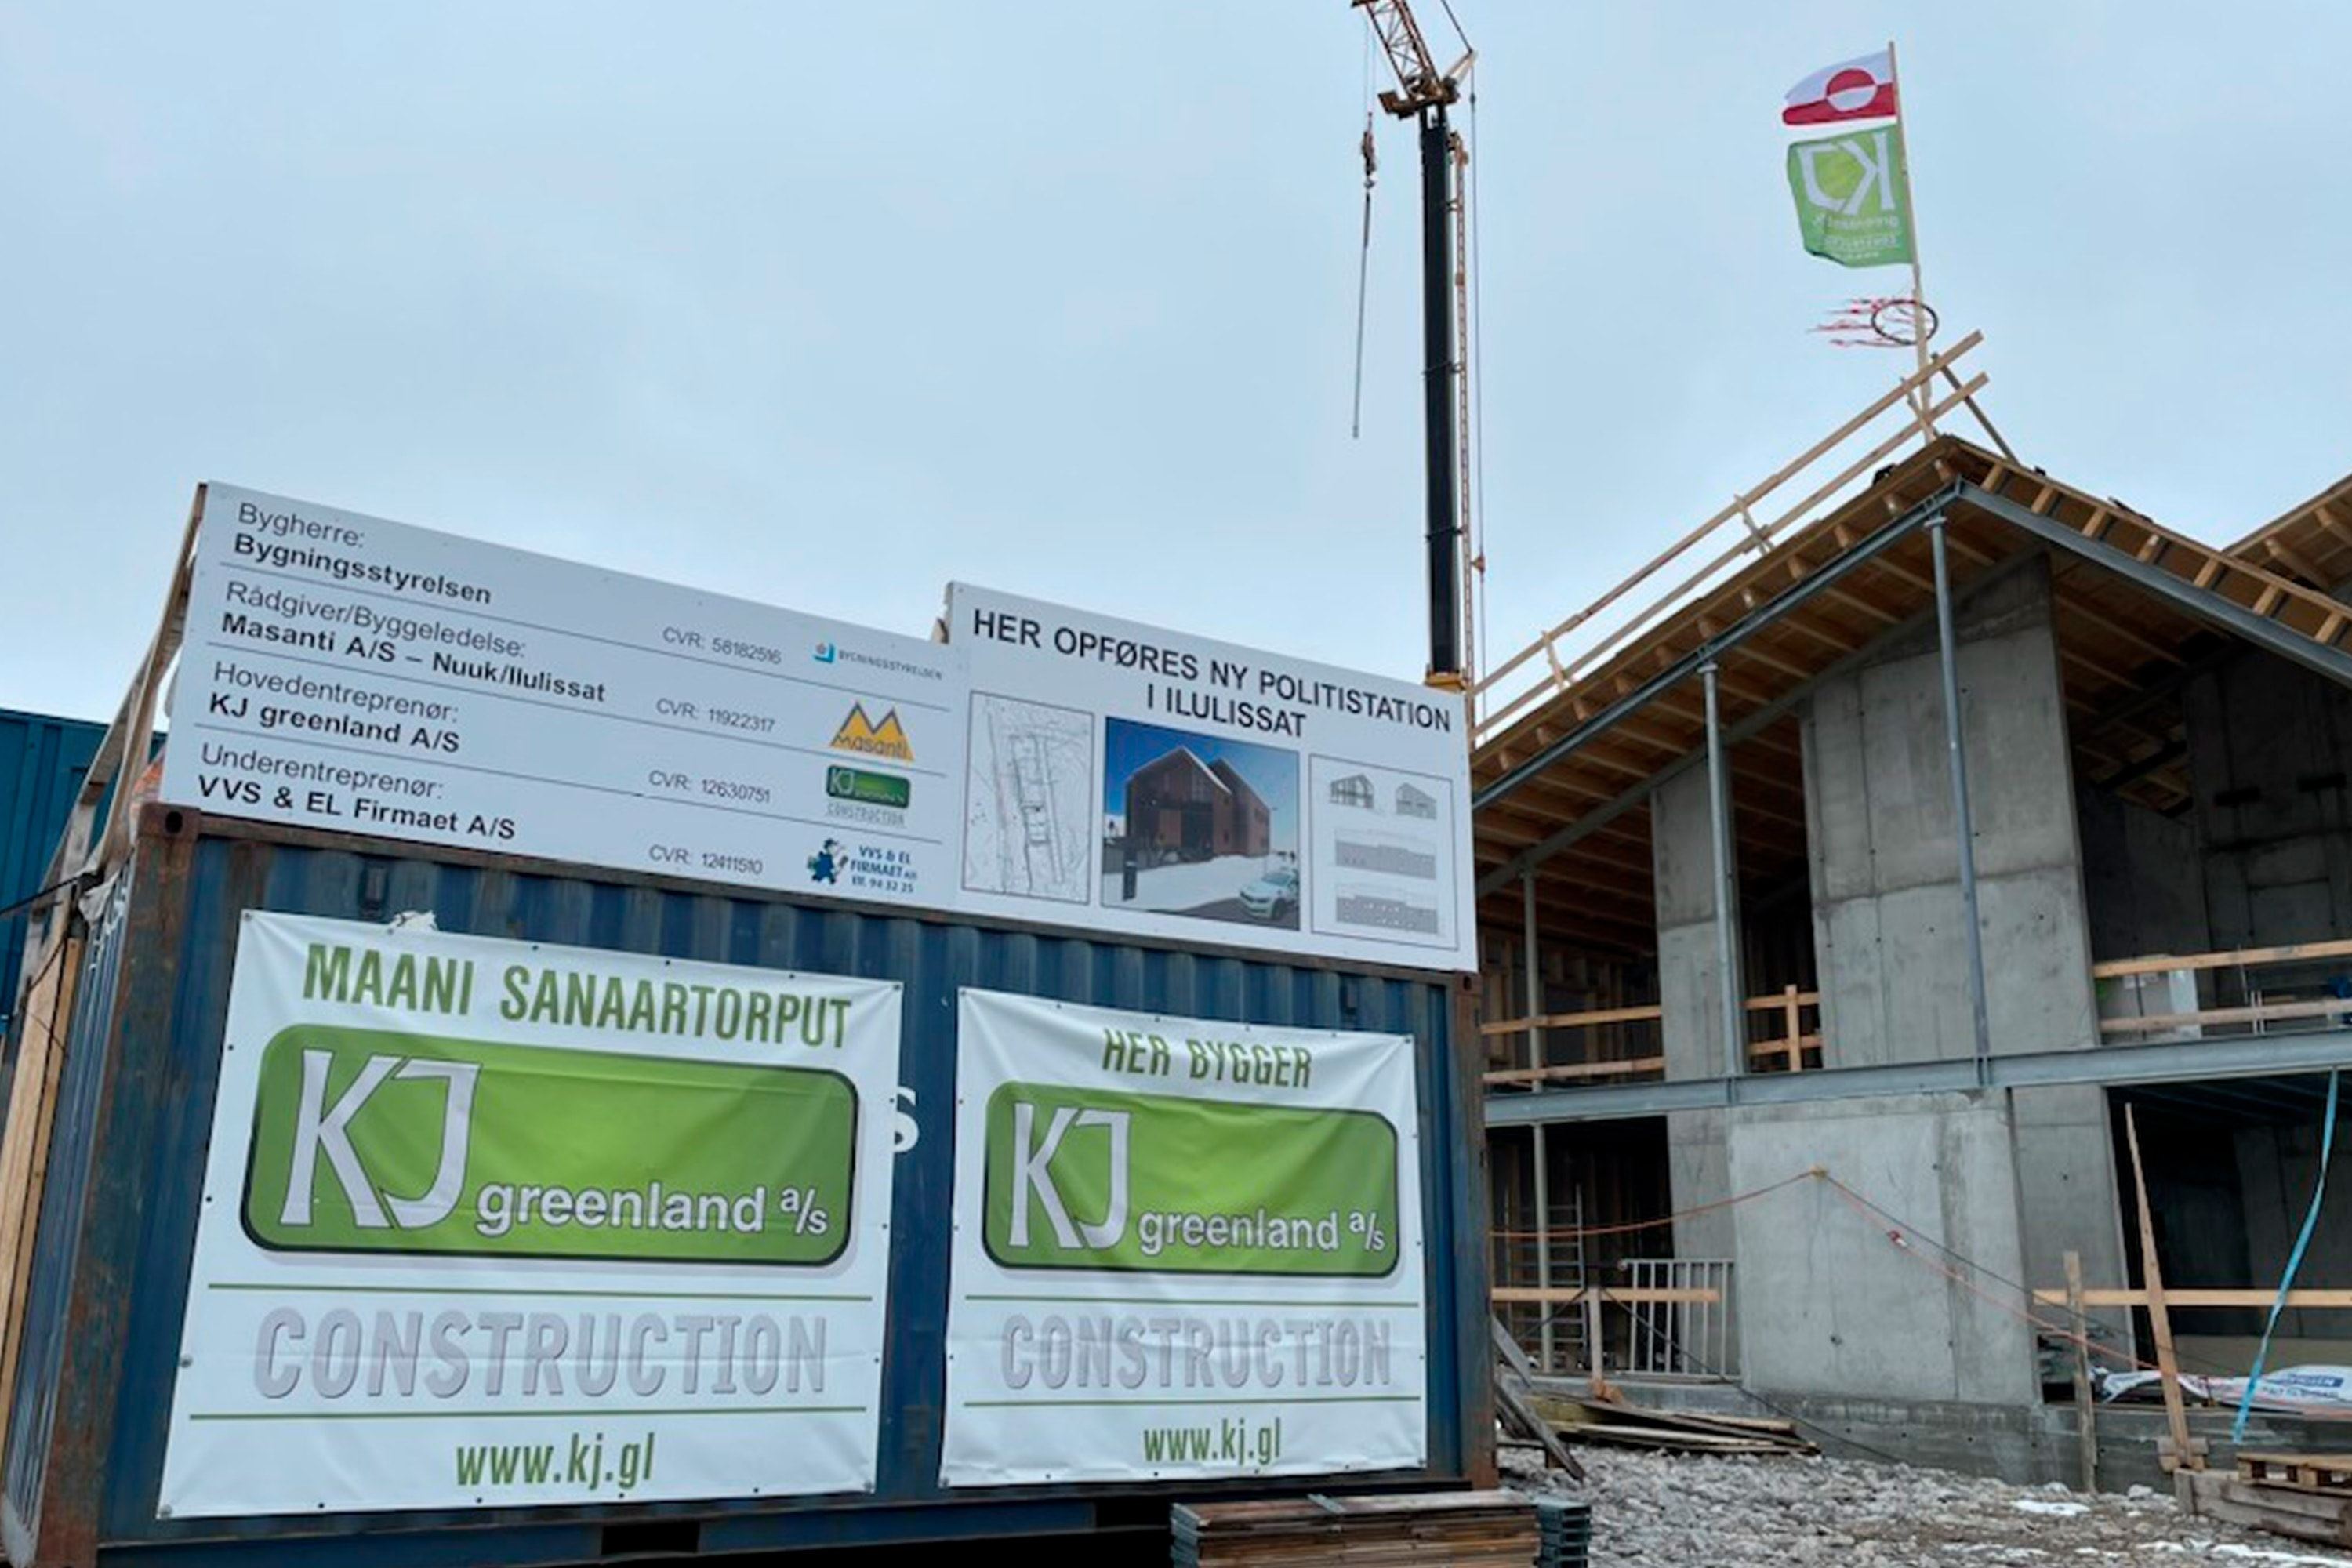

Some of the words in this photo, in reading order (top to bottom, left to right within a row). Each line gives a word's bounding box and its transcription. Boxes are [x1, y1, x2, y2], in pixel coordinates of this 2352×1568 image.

[238, 503, 365, 547] Bygherre:
[234, 532, 492, 601] Bygningsstyrelsen
[226, 580, 525, 657] Rådgiver/Byggeledelse:
[662, 626, 705, 649] CVR:
[221, 612, 336, 651] Masanti
[345, 636, 396, 662] A/S
[433, 652, 605, 702] Nuuk/Ilulissat
[974, 608, 1041, 648] HER
[1054, 627, 1198, 680] OPFØRES
[1211, 660, 1249, 689] NY
[1260, 671, 1450, 732] POLITISTATION
[214, 661, 459, 723] Hovedentreprenør:
[656, 698, 699, 720] CVR:
[709, 708, 775, 733] 11922317
[1148, 684, 1153, 708] I
[1167, 688, 1306, 738] ILULISSAT
[209, 692, 248, 718] KJ
[260, 705, 401, 742] greenland
[410, 728, 459, 753] A/S
[201, 742, 443, 799] Underentreprenør:
[648, 770, 691, 790] CVR:
[702, 779, 770, 803] 12630751
[198, 775, 261, 804] VVS
[274, 786, 294, 809] &
[307, 791, 342, 816] EL
[354, 797, 458, 832] Firmaet
[467, 815, 515, 840] A/S
[648, 844, 691, 865] CVR:
[702, 853, 763, 875] 12411510
[303, 943, 474, 1015] MAANI
[500, 965, 852, 1049] SANAARTORPUT
[1102, 1028, 1171, 1076] HER
[1189, 1040, 1312, 1088] BYGGER
[279, 1047, 482, 1231] KJ
[1007, 1102, 1132, 1250] KJ
[476, 1182, 766, 1237] greenland
[779, 1187, 829, 1236] a/s
[1138, 1208, 1339, 1256] greenland
[1348, 1211, 1385, 1251] a/s
[253, 1307, 828, 1399] CONSTRUCTION
[1001, 1313, 1392, 1390] CONSTRUCTION
[456, 1432, 654, 1489] www.kj.gl
[1144, 1417, 1281, 1465] www.kj.gl
